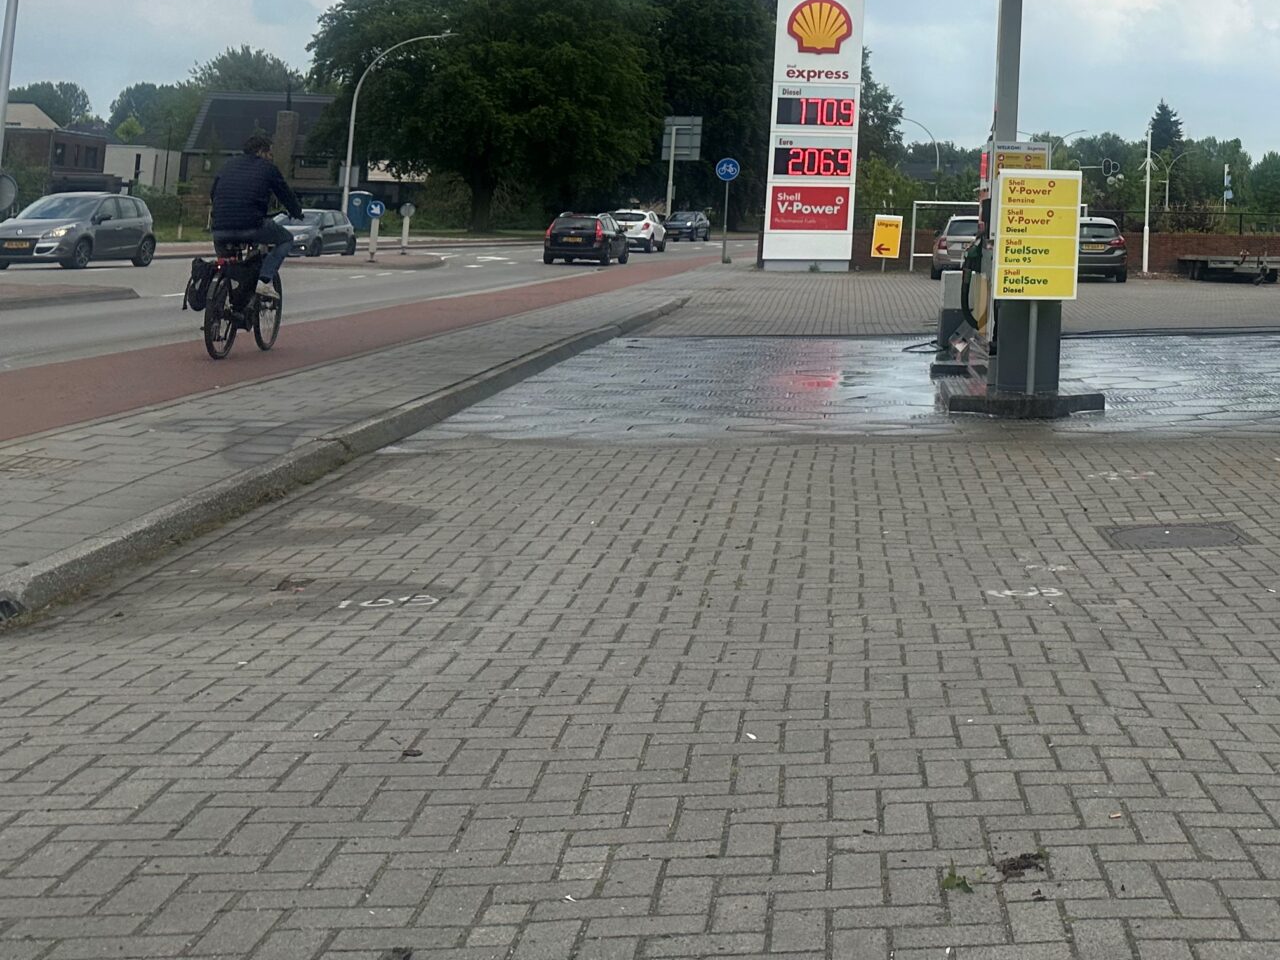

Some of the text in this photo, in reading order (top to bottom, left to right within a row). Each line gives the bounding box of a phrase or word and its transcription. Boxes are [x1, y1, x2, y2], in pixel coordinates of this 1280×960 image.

[786, 68, 849, 81] express
[782, 88, 802, 96] Diesel
[800, 98, 854, 126] 170.9
[779, 138, 794, 146] Euro
[788, 148, 852, 176] 206.9
[1009, 187, 1052, 195] V-Power
[777, 192, 801, 201] Shell
[777, 202, 840, 215] V-Power
[1008, 216, 1050, 225] V-Power
[1005, 246, 1050, 255] FuelSave
[1003, 276, 1048, 285] FuelSave
